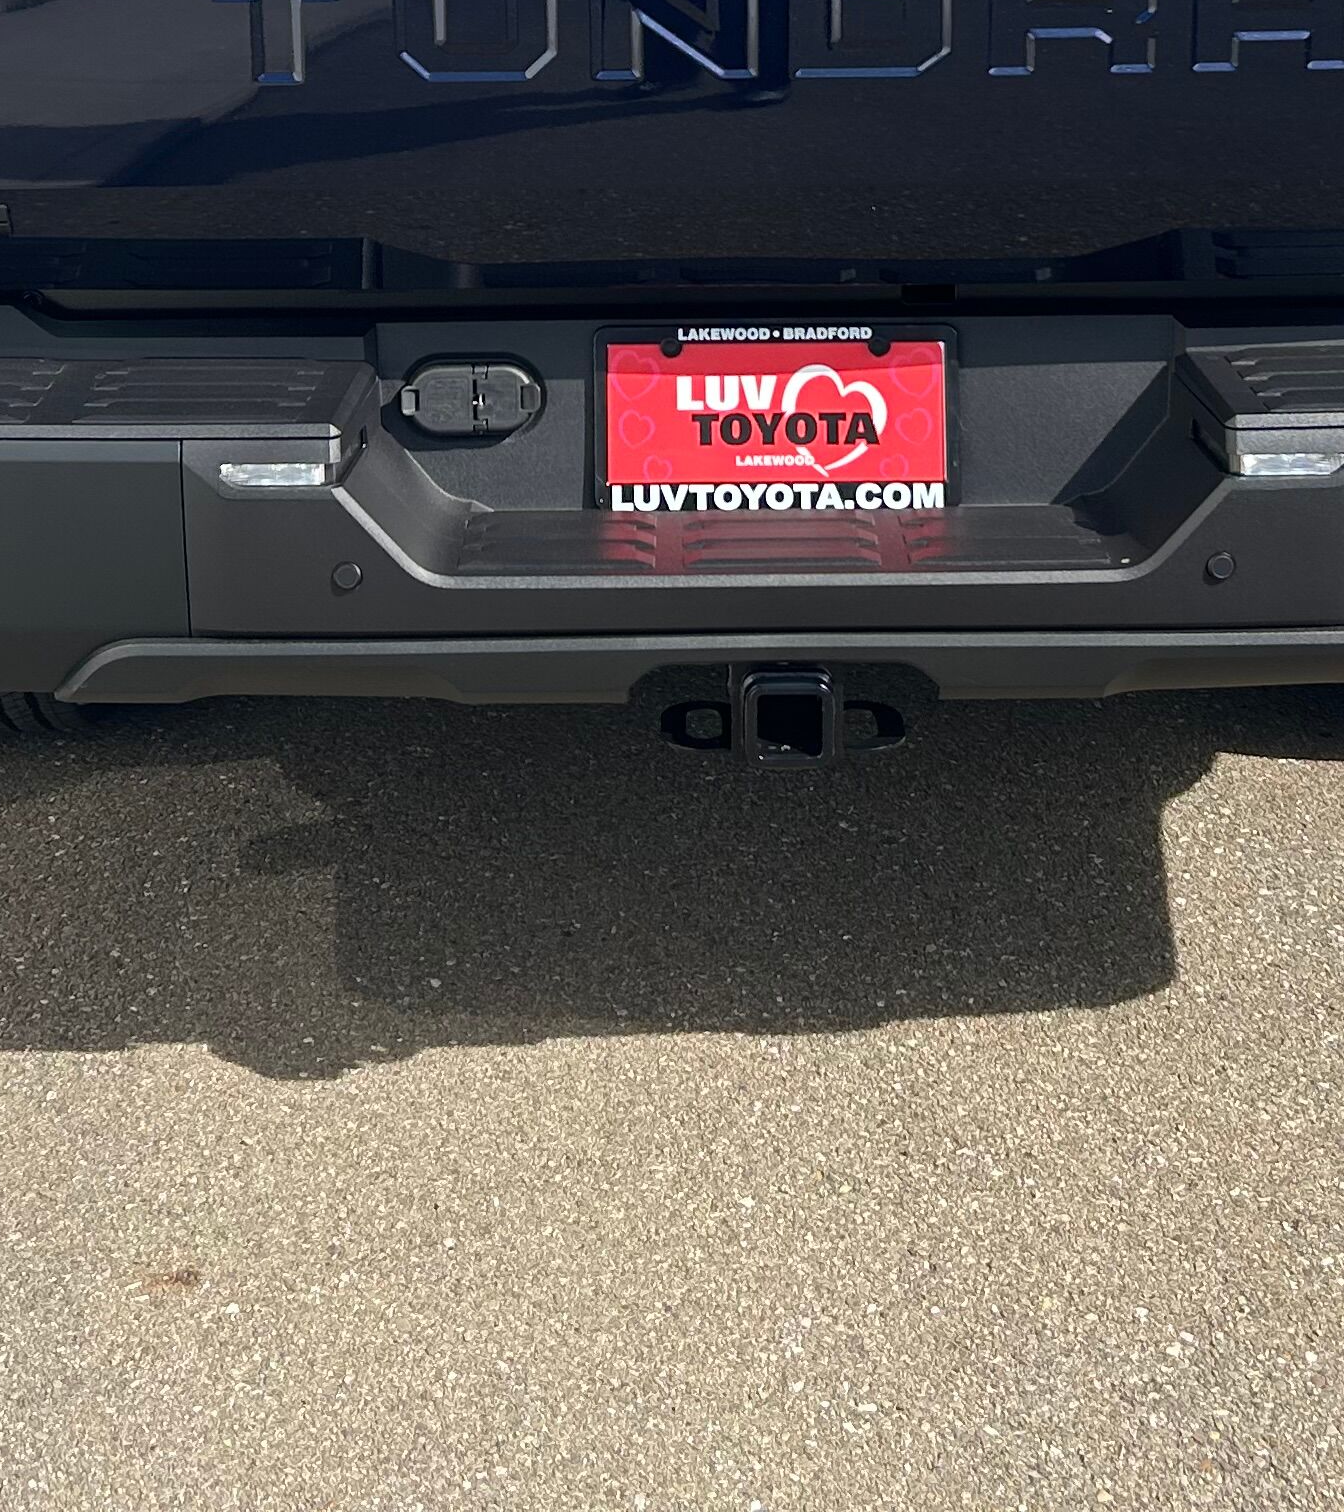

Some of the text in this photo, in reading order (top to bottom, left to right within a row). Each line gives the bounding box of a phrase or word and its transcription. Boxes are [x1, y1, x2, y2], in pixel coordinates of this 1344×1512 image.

[677, 327, 873, 341] LAKEWOOD BRADFORD
[675, 374, 777, 411] LUV
[691, 412, 881, 446] TOYOTA
[735, 455, 815, 467] LAKEWOOD
[611, 482, 945, 512] LUVTOYOTA.COM
